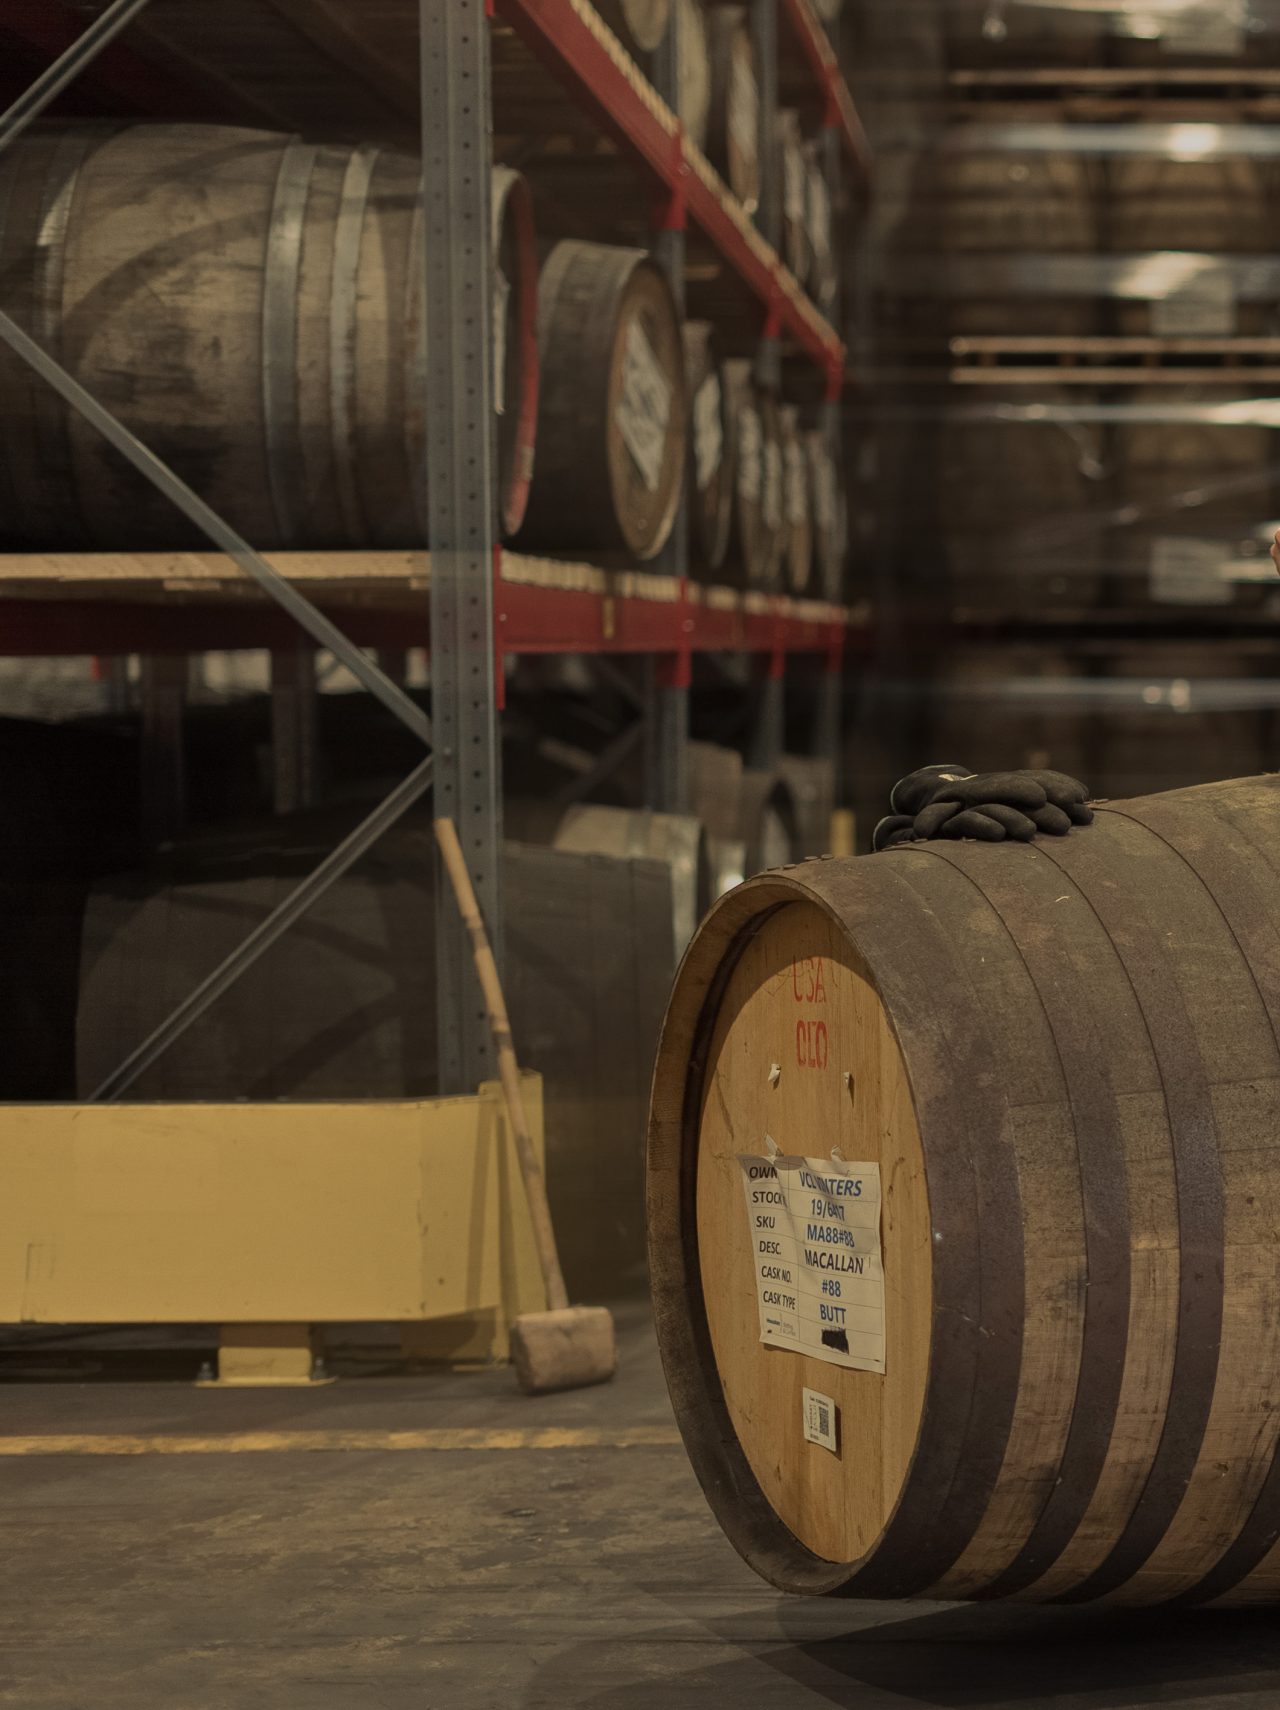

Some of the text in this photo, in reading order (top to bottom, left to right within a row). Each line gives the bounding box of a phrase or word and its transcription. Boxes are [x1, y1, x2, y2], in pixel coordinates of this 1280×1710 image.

[756, 1215, 775, 1229] SKU
[759, 1240, 782, 1255] DESC.
[804, 1249, 864, 1275] MACALLAN
[761, 1265, 781, 1281] CASK
[821, 1279, 842, 1299] #88
[763, 1290, 796, 1311] CASK TYPE
[819, 1303, 847, 1325] BUTT
